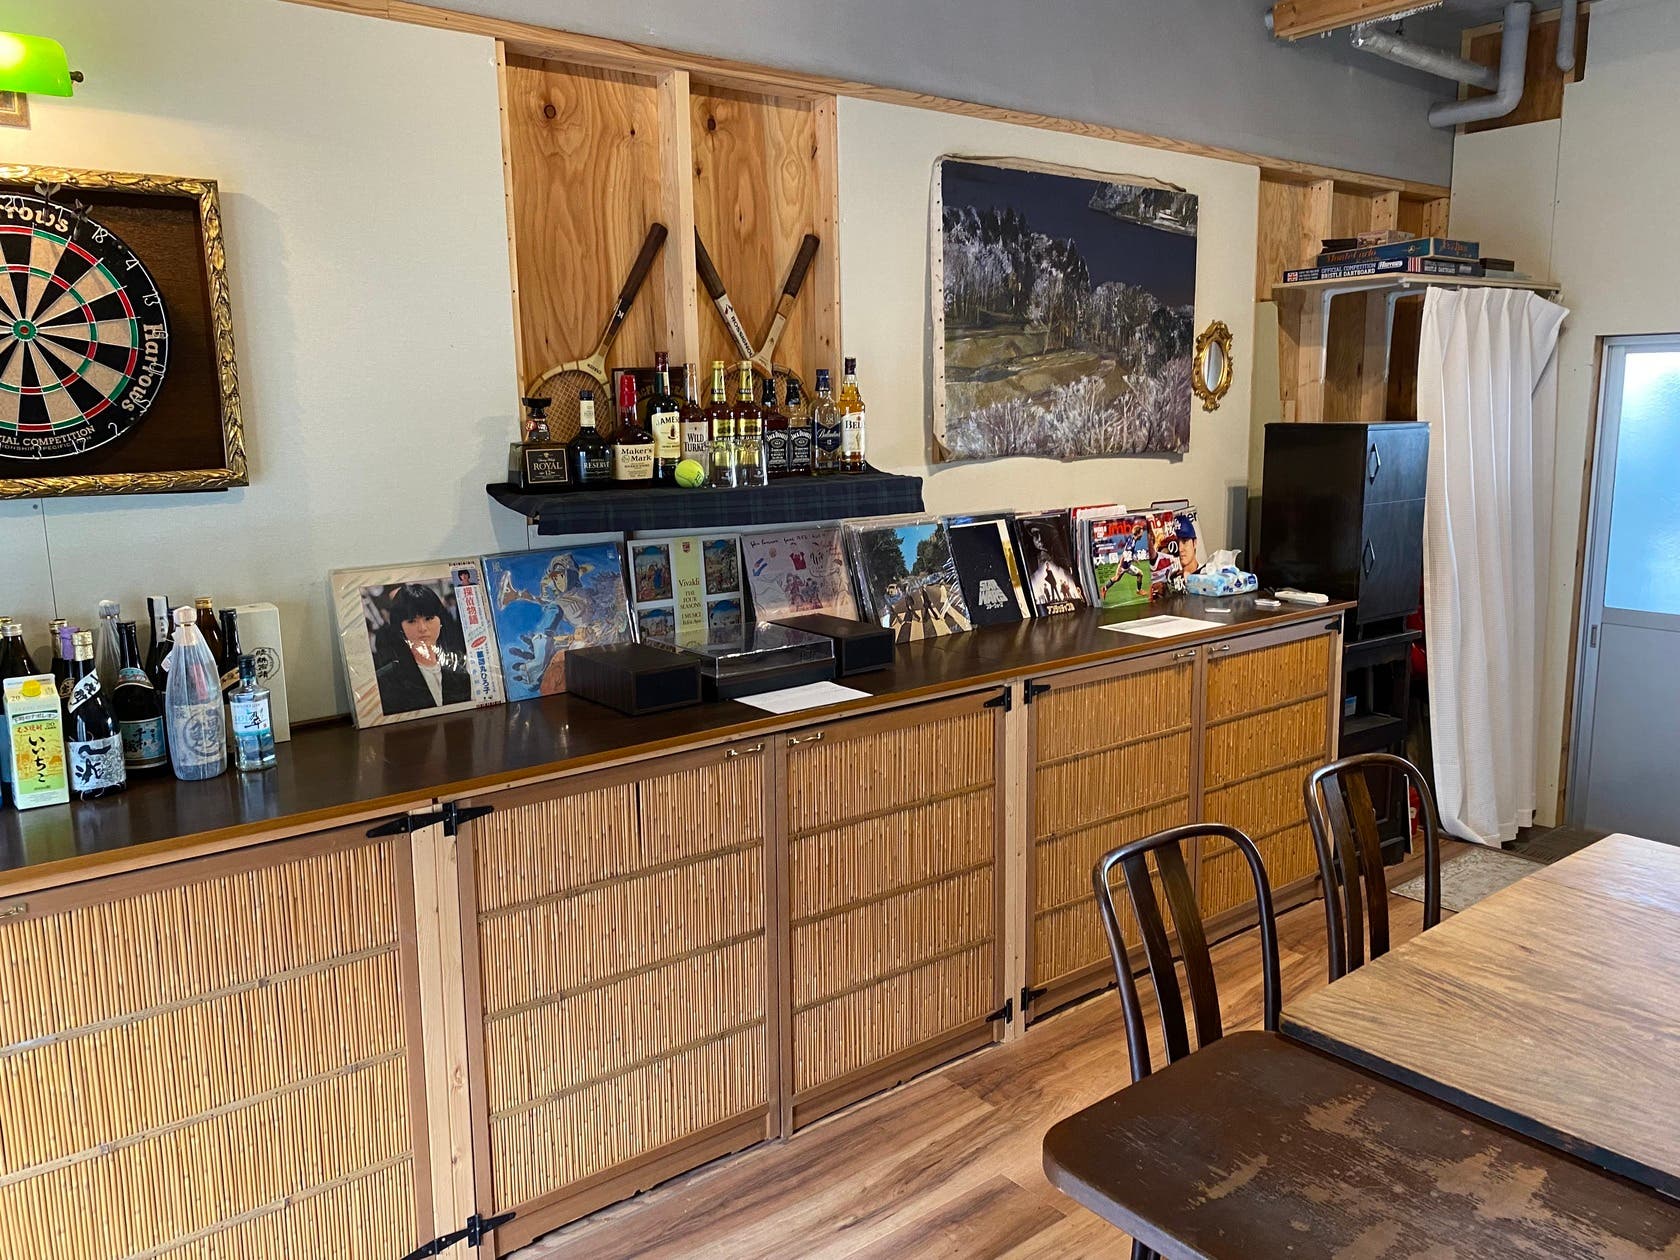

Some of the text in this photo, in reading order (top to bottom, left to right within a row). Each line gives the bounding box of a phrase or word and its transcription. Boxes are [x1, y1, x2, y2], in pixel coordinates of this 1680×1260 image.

[0, 203, 69, 233] rows
[91, 224, 109, 243] 18
[125, 259, 140, 271] 4
[142, 290, 161, 306] 13
[730, 315, 754, 359] ROSSIGNOL
[121, 323, 164, 412] Harrows
[22, 426, 96, 447] COMPETITION
[687, 433, 705, 442] WILD
[621, 447, 653, 455] Maker's
[533, 461, 563, 471] ROYAL
[678, 577, 700, 587] Vivaldi
[28, 736, 47, 782] いいちこ
